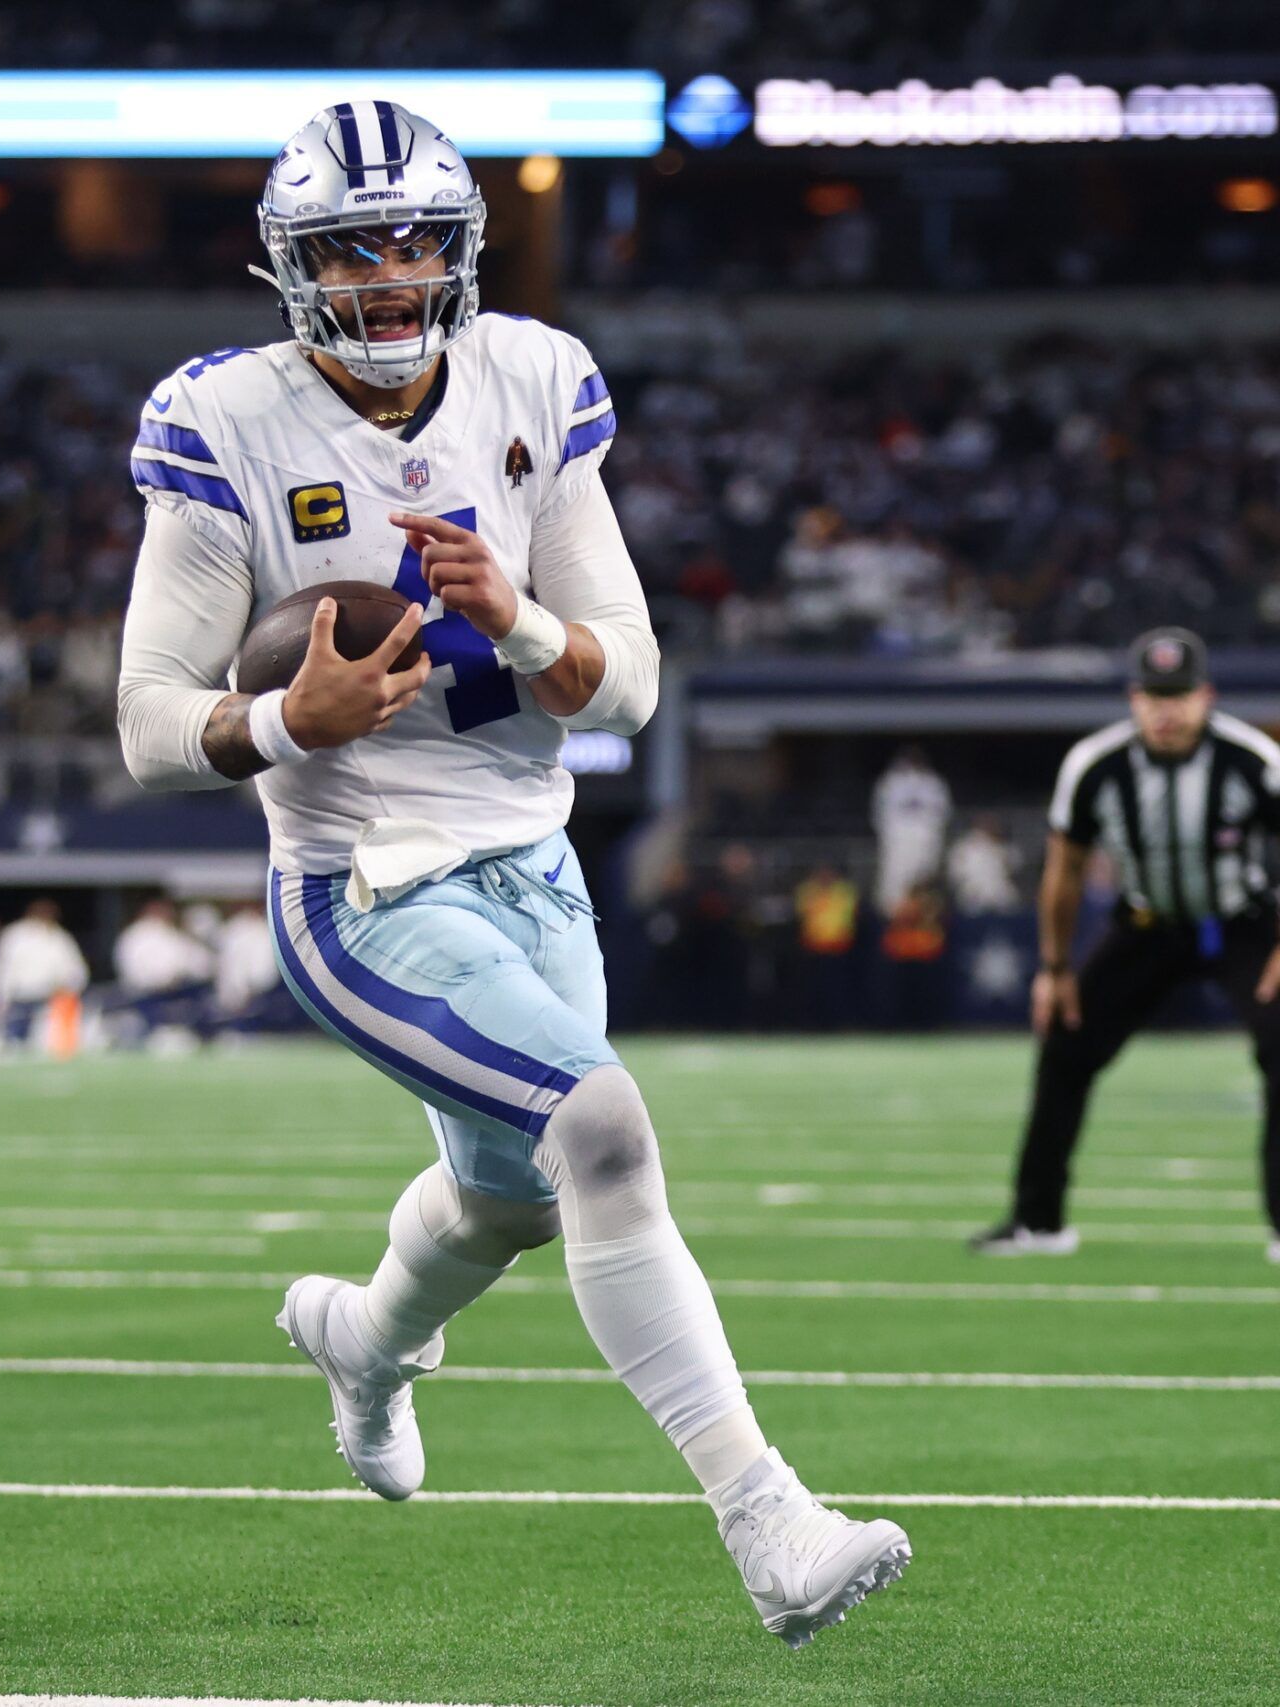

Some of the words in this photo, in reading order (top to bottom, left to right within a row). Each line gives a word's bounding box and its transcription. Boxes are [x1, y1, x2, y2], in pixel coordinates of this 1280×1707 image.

[354, 190, 405, 203] COWBOYS
[406, 471, 427, 486] NFL
[293, 486, 344, 528] C
